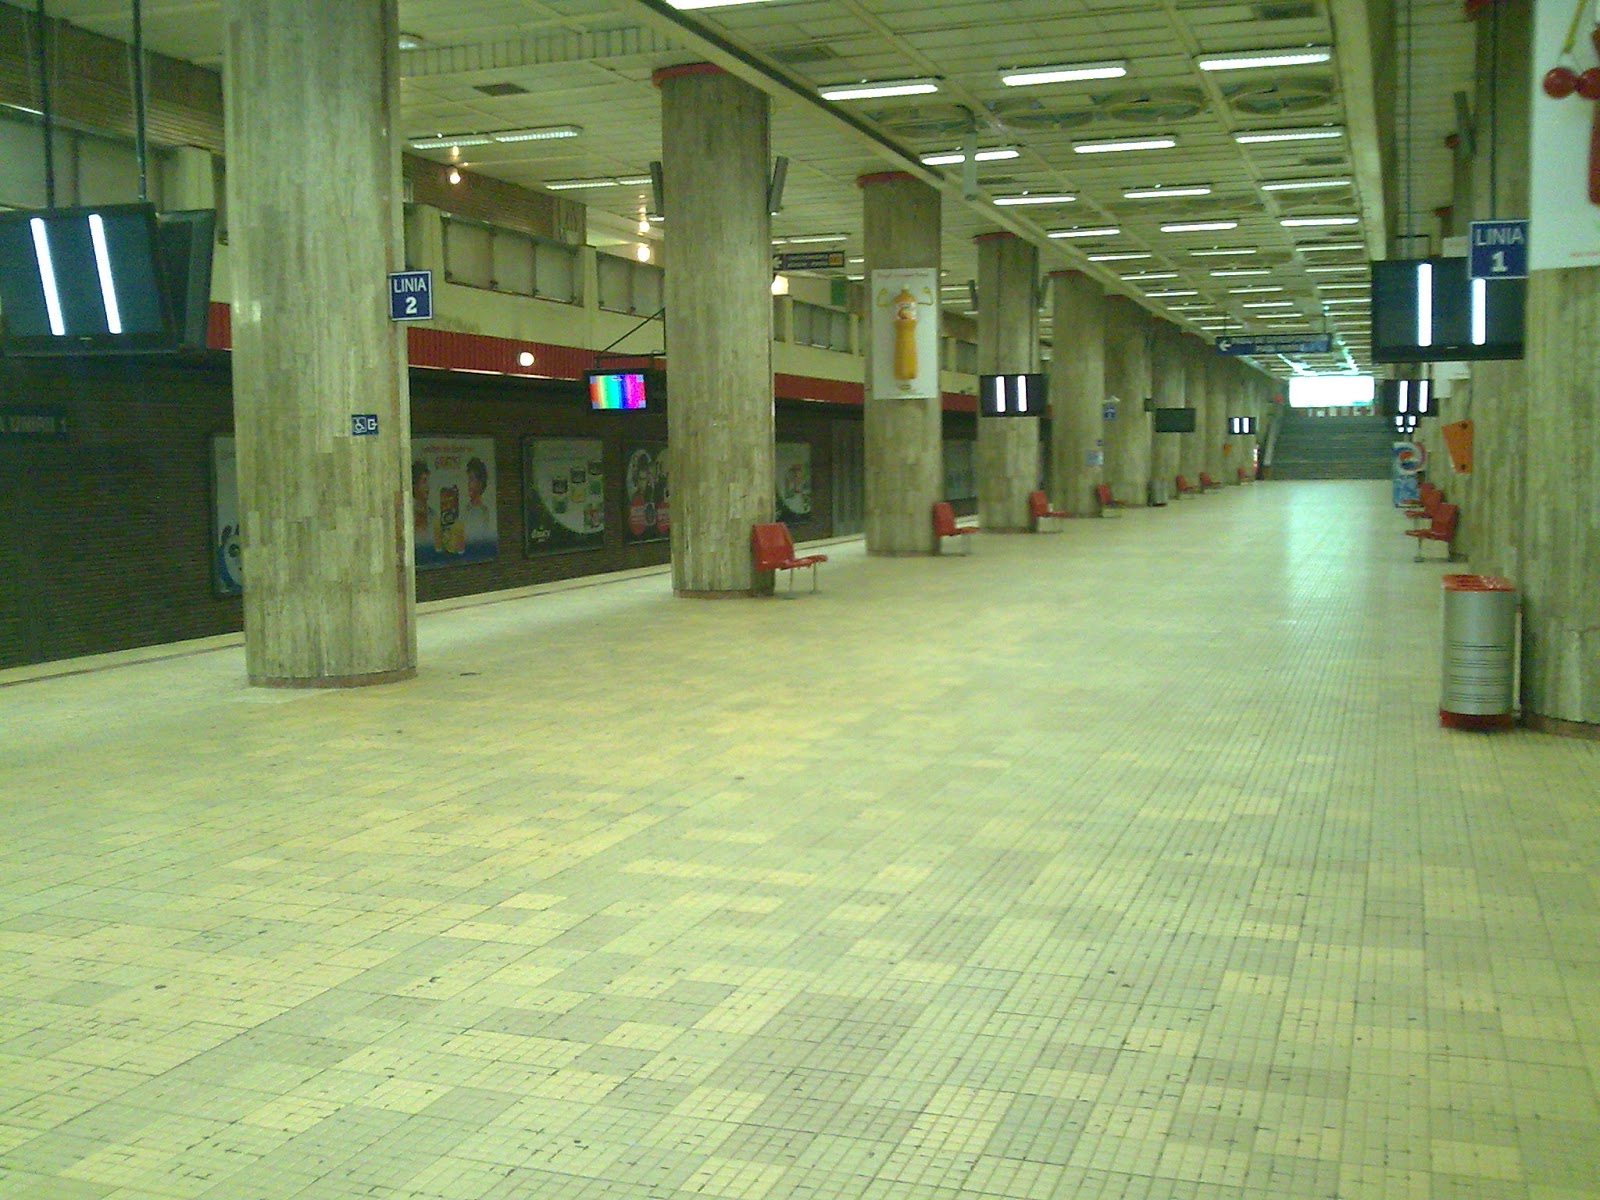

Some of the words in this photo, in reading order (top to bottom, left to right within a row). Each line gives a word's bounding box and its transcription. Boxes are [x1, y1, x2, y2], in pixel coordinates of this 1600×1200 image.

[1475, 228, 1524, 245] LINIA
[1492, 251, 1507, 271] 1
[393, 278, 427, 293] LINIA
[405, 296, 418, 314] 2
